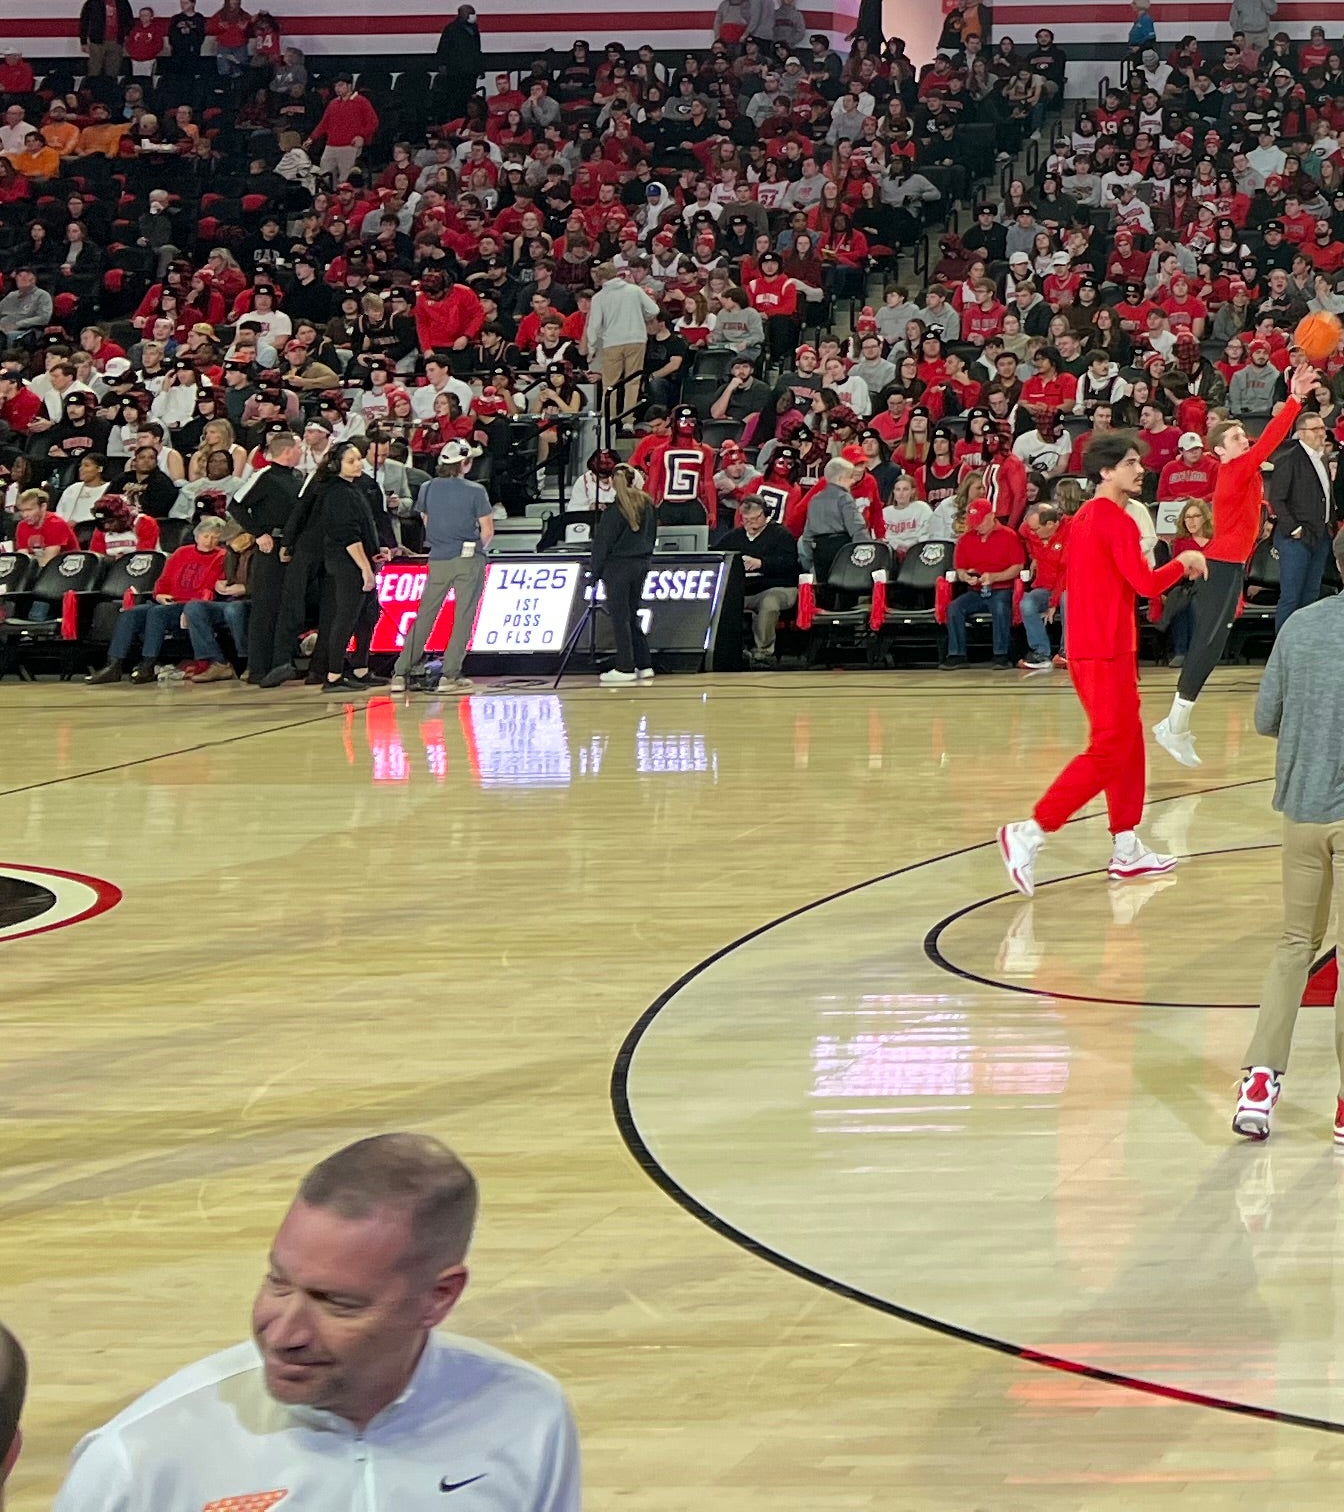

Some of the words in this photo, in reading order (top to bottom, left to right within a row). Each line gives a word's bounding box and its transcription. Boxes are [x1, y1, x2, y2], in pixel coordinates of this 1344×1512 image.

[664, 449, 704, 501] G
[495, 568, 569, 590] 14:25
[503, 614, 541, 627] POSS
[507, 630, 532, 643] FLS
